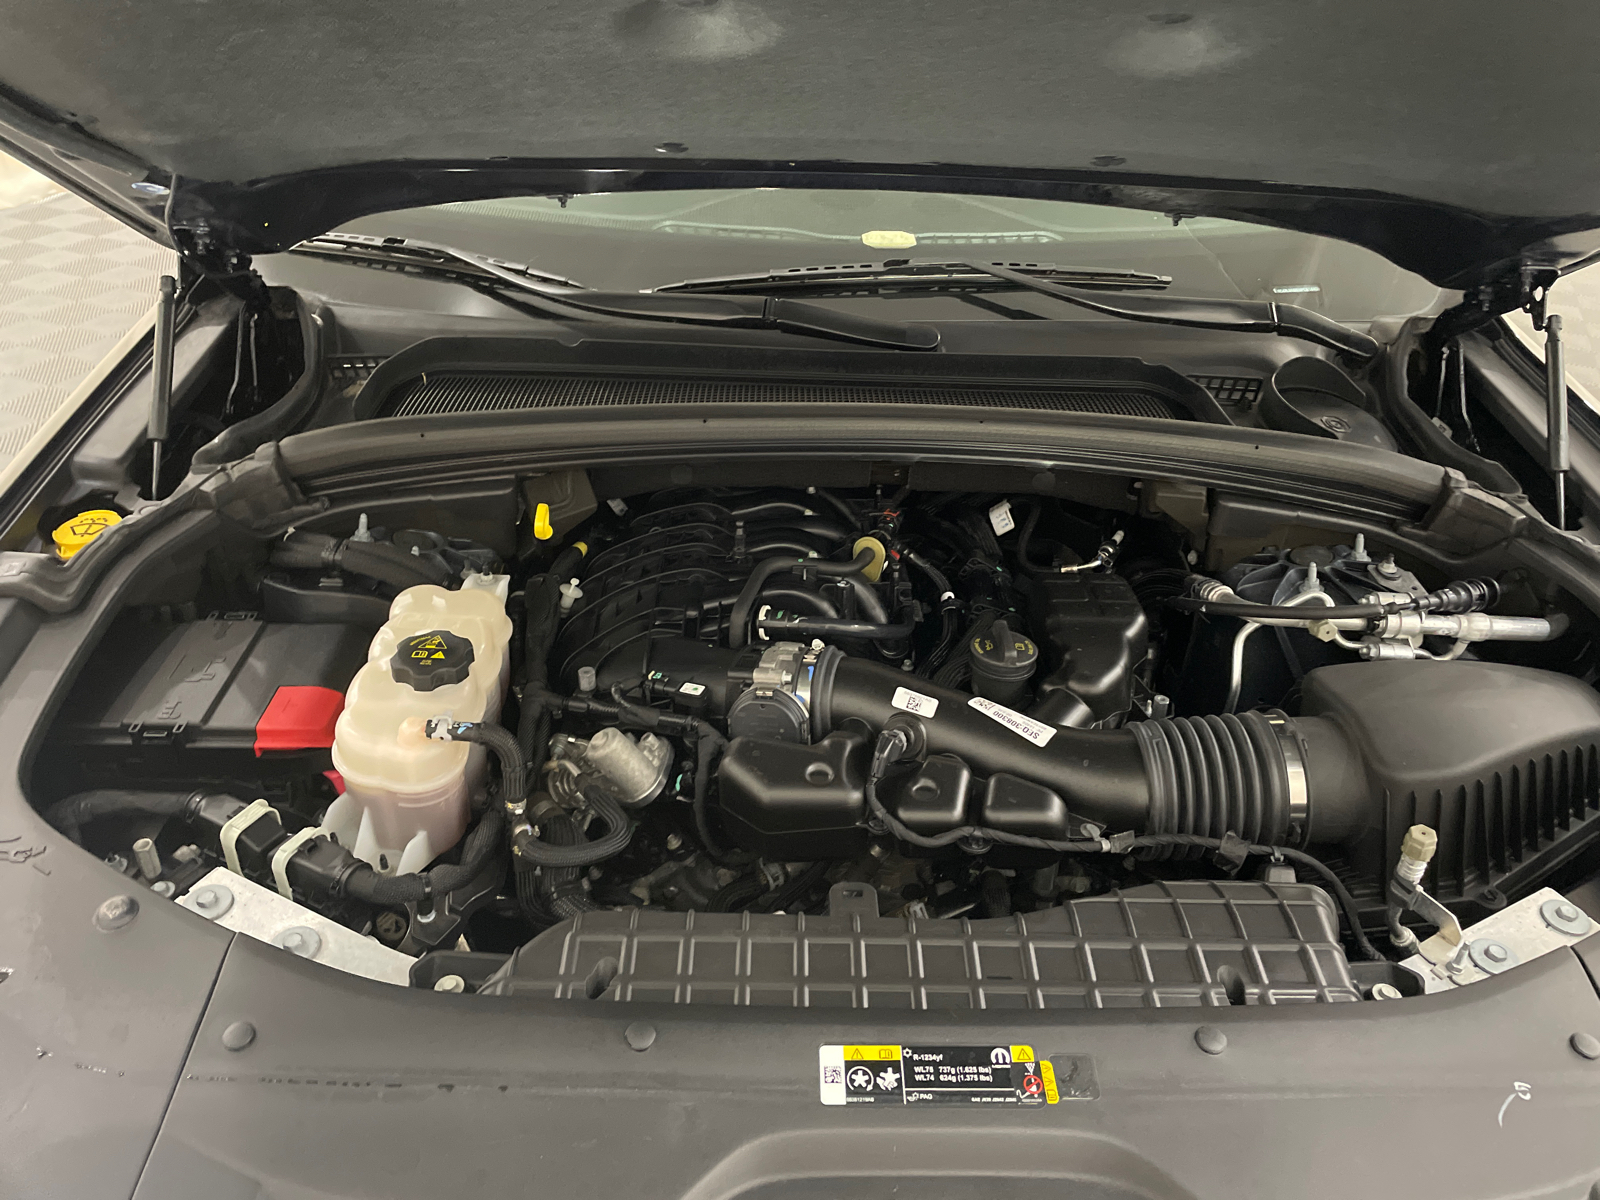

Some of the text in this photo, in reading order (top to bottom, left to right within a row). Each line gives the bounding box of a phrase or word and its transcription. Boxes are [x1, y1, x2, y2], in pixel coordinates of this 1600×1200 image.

[912, 1053, 944, 1063] R-1234yf
[938, 1066, 955, 1074] 737g
[978, 1066, 992, 1074] lbs)
[957, 1074, 978, 1083] (1.375
[979, 1074, 993, 1083] lbs)
